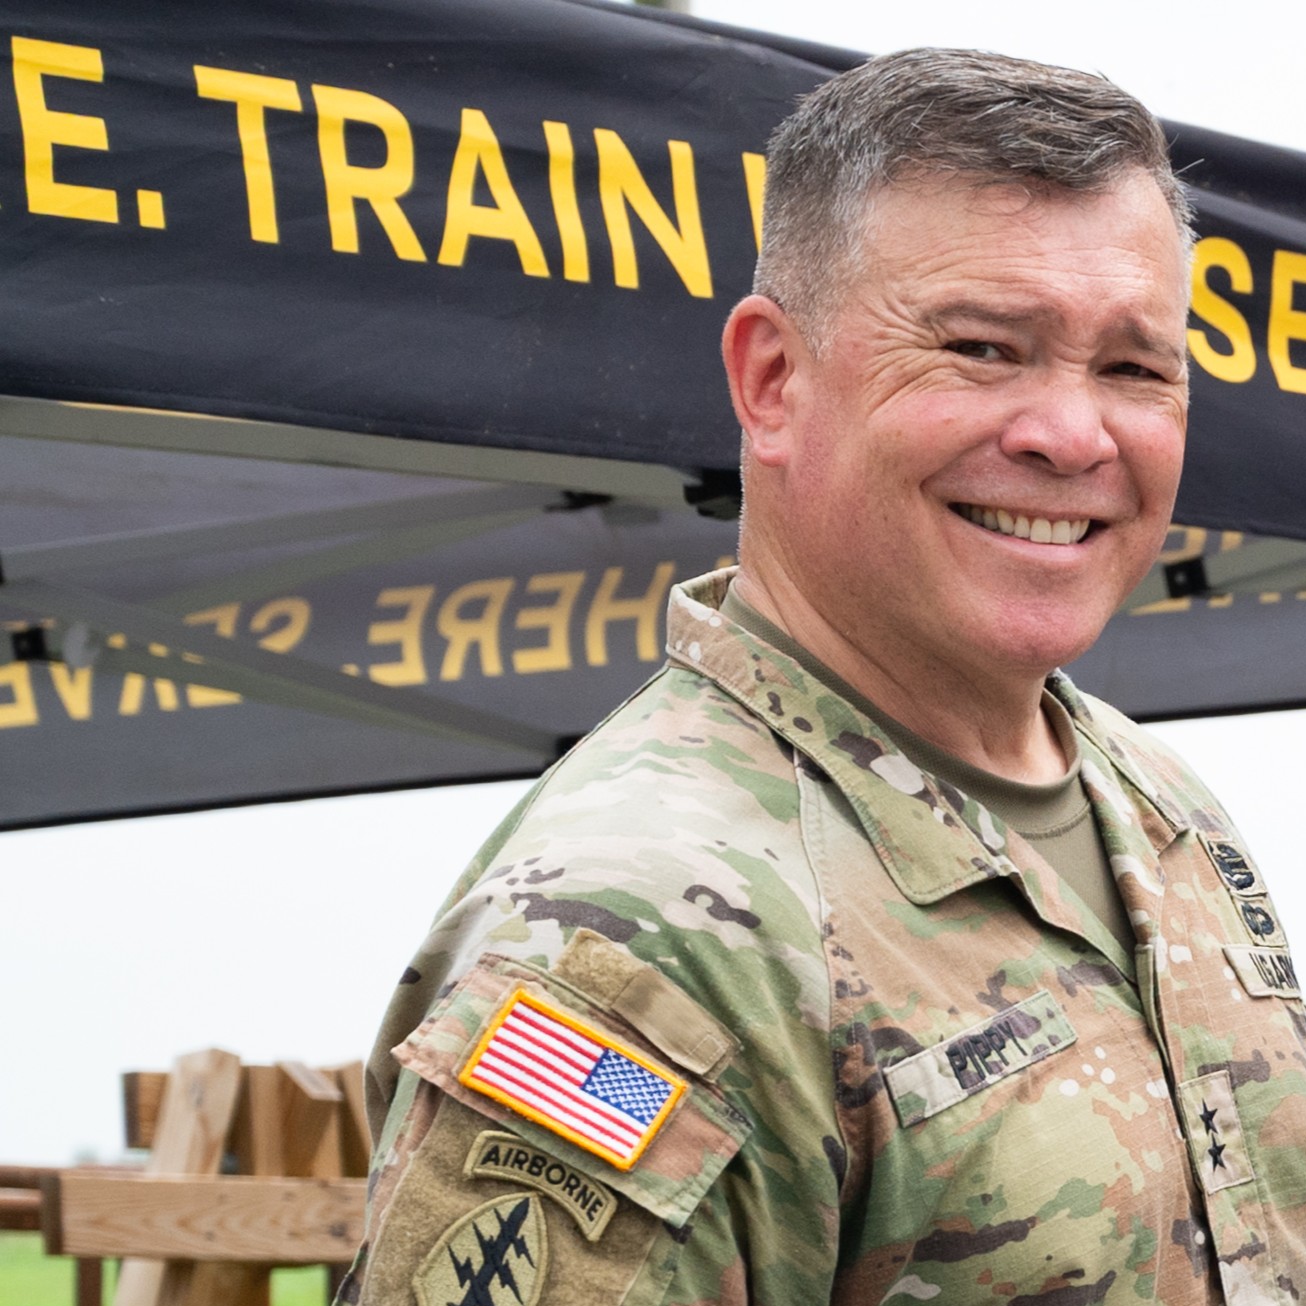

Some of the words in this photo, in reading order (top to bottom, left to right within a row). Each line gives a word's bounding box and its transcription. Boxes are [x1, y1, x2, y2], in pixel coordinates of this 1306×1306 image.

[193, 65, 714, 299] TRAIN
[945, 1020, 1028, 1090] PIPPY
[480, 1145, 603, 1222] AIRBORNE
